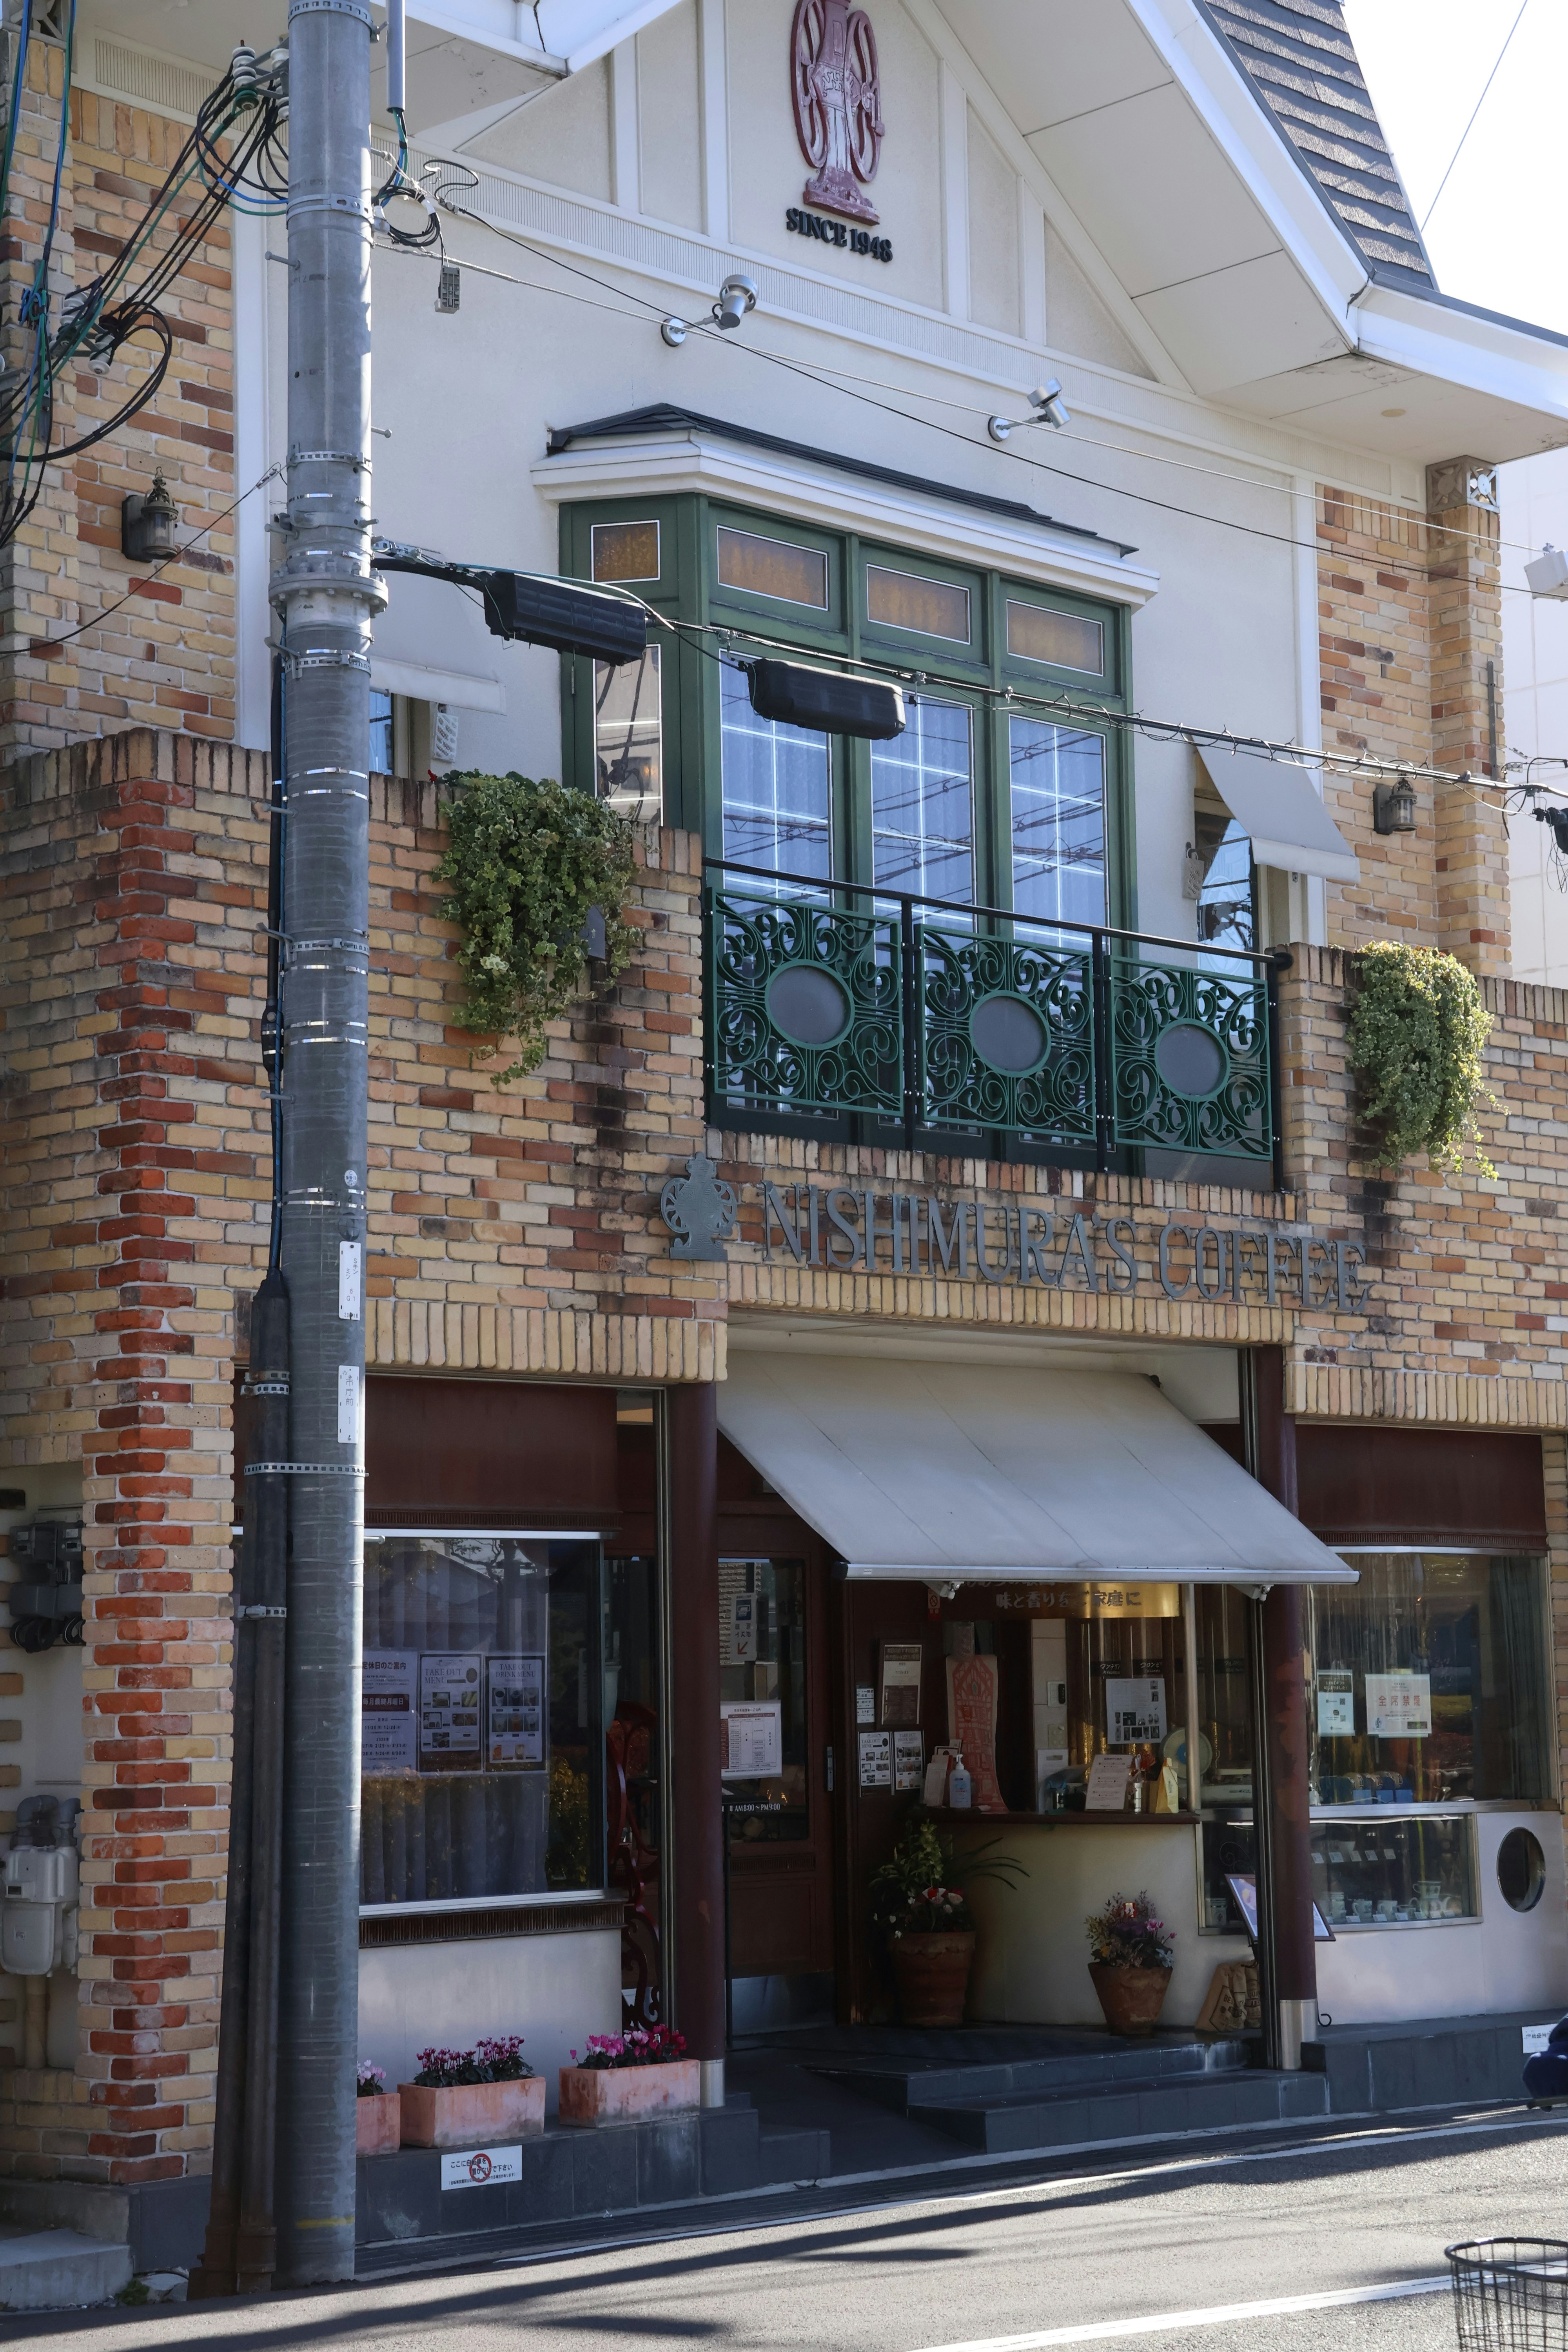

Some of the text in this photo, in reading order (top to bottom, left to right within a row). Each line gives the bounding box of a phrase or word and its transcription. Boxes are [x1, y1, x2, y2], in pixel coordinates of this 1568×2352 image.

[786, 208, 893, 263] SINCE 1948
[762, 1180, 1368, 1314] NISHIMURA'S COFFEE
[345, 1375, 354, 1406] 市庁前
[996, 1590, 1142, 1609] 味と香りをご家庭に
[362, 1661, 406, 1670] 定休日のご案内
[1379, 1695, 1421, 1706] 全席禁煙
[451, 2158, 487, 2168] ここに自転車を
[472, 2164, 512, 2175] 置かないで下さい
